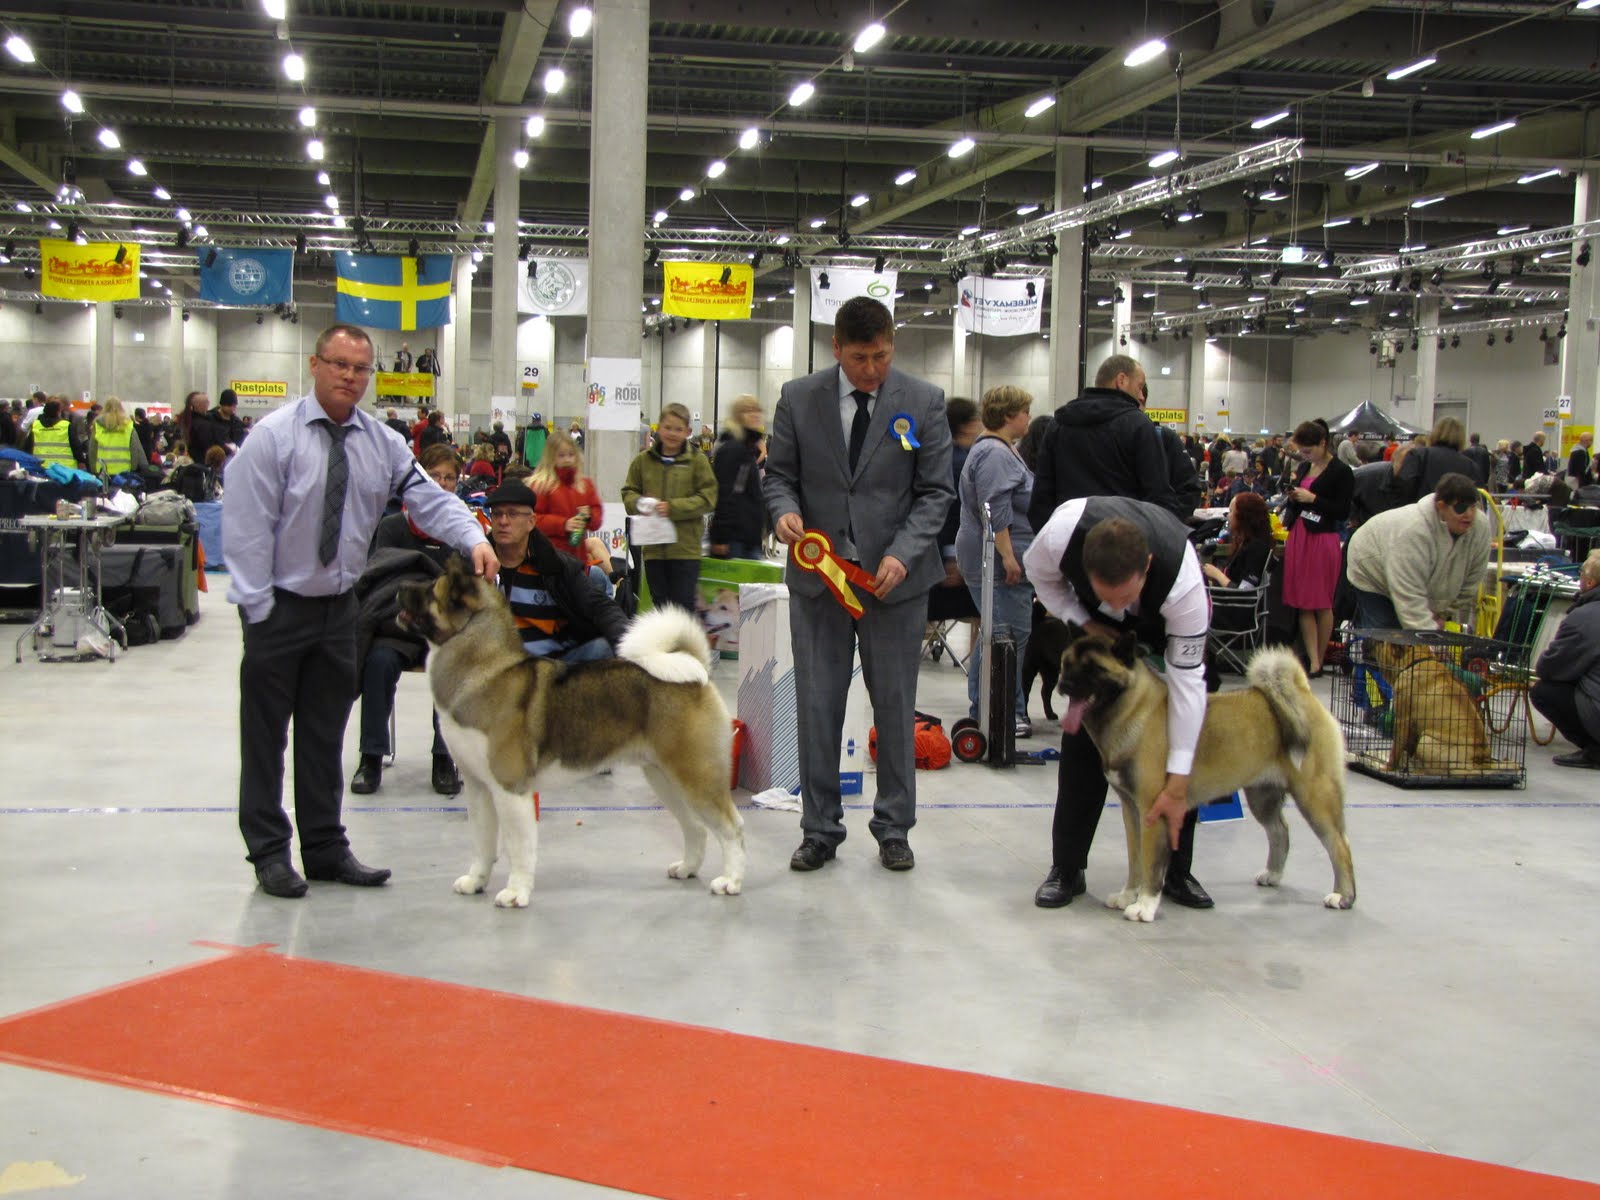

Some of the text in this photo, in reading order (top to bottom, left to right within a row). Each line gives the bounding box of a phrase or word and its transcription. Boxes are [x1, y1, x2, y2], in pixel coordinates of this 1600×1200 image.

[524, 367, 539, 377] 29
[234, 382, 284, 394] Rastplats
[1560, 399, 1570, 408] 27
[1145, 410, 1183, 421] astplats
[1544, 410, 1556, 418] 20
